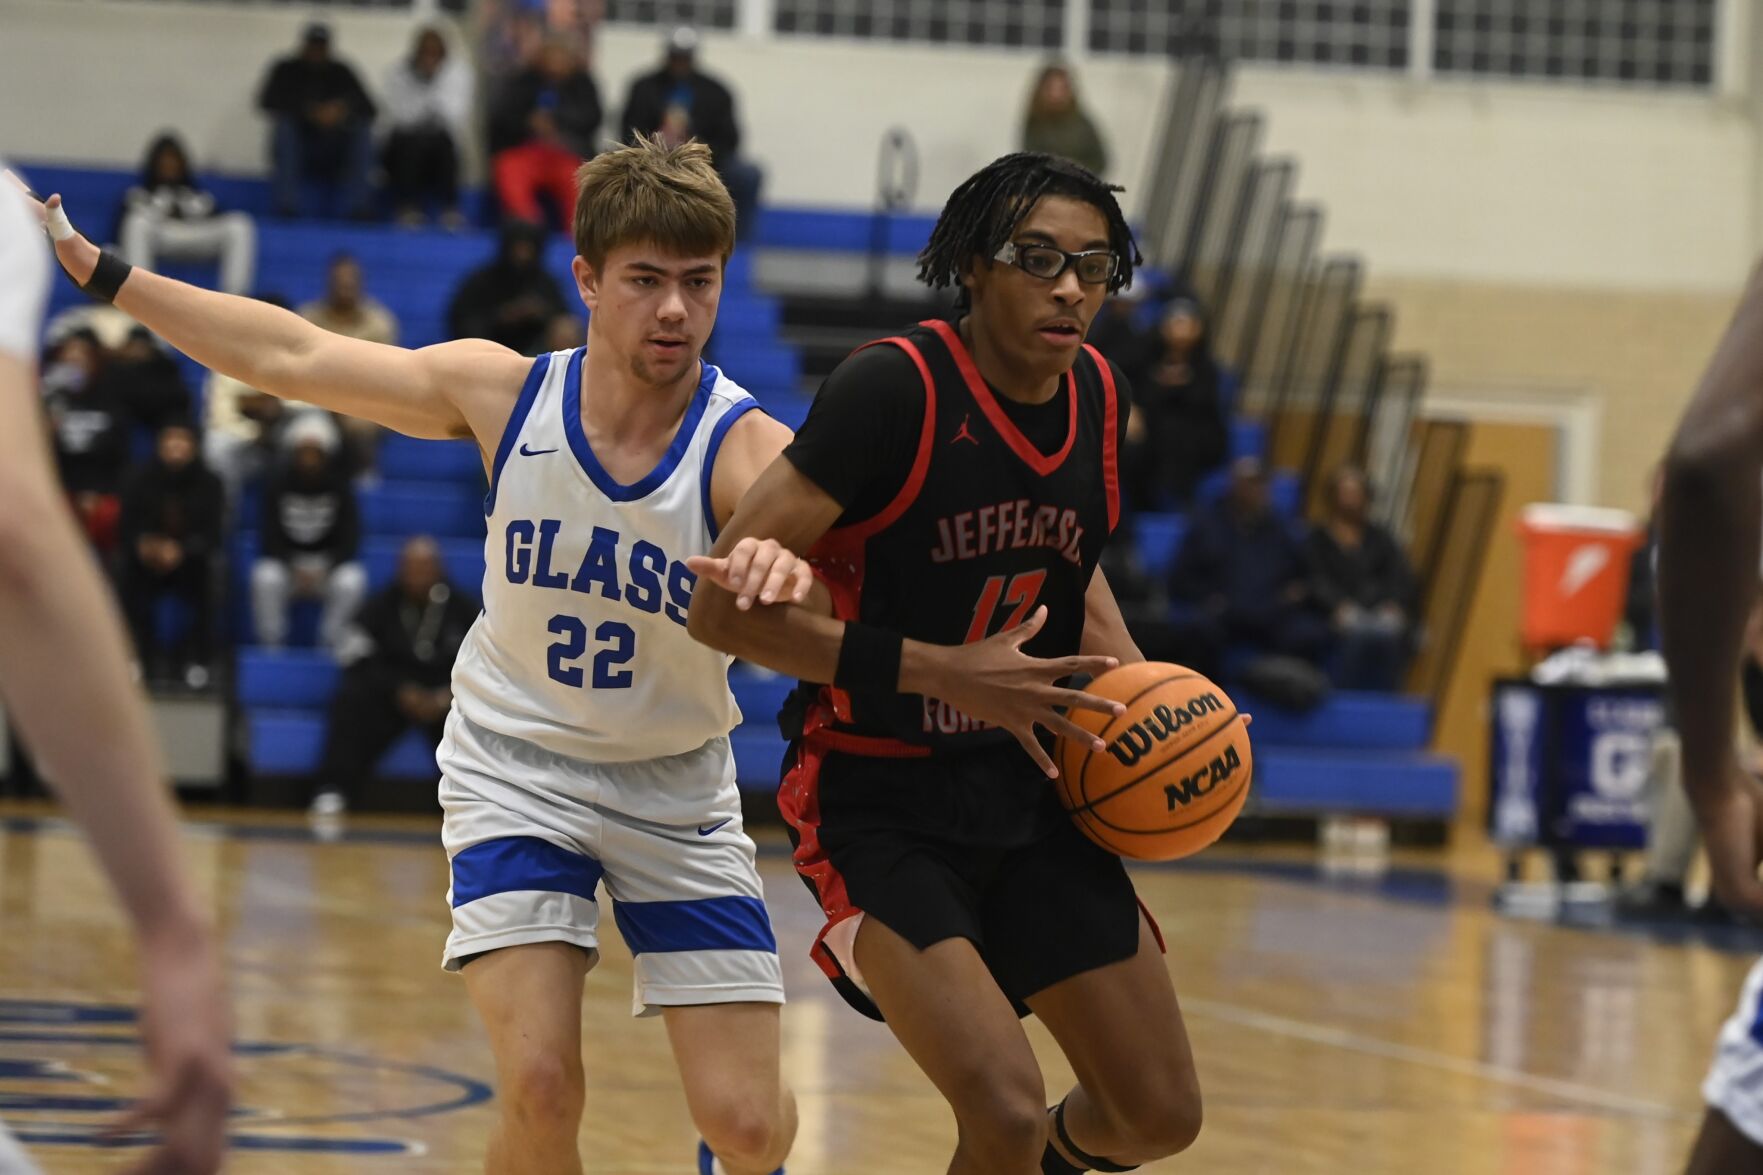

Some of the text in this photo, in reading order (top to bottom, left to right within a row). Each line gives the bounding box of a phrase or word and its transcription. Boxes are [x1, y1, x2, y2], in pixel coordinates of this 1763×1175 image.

[505, 518, 698, 628] GLASS
[546, 613, 636, 689] 22
[1105, 692, 1225, 767] Wilson
[1164, 743, 1241, 812] NCAA
